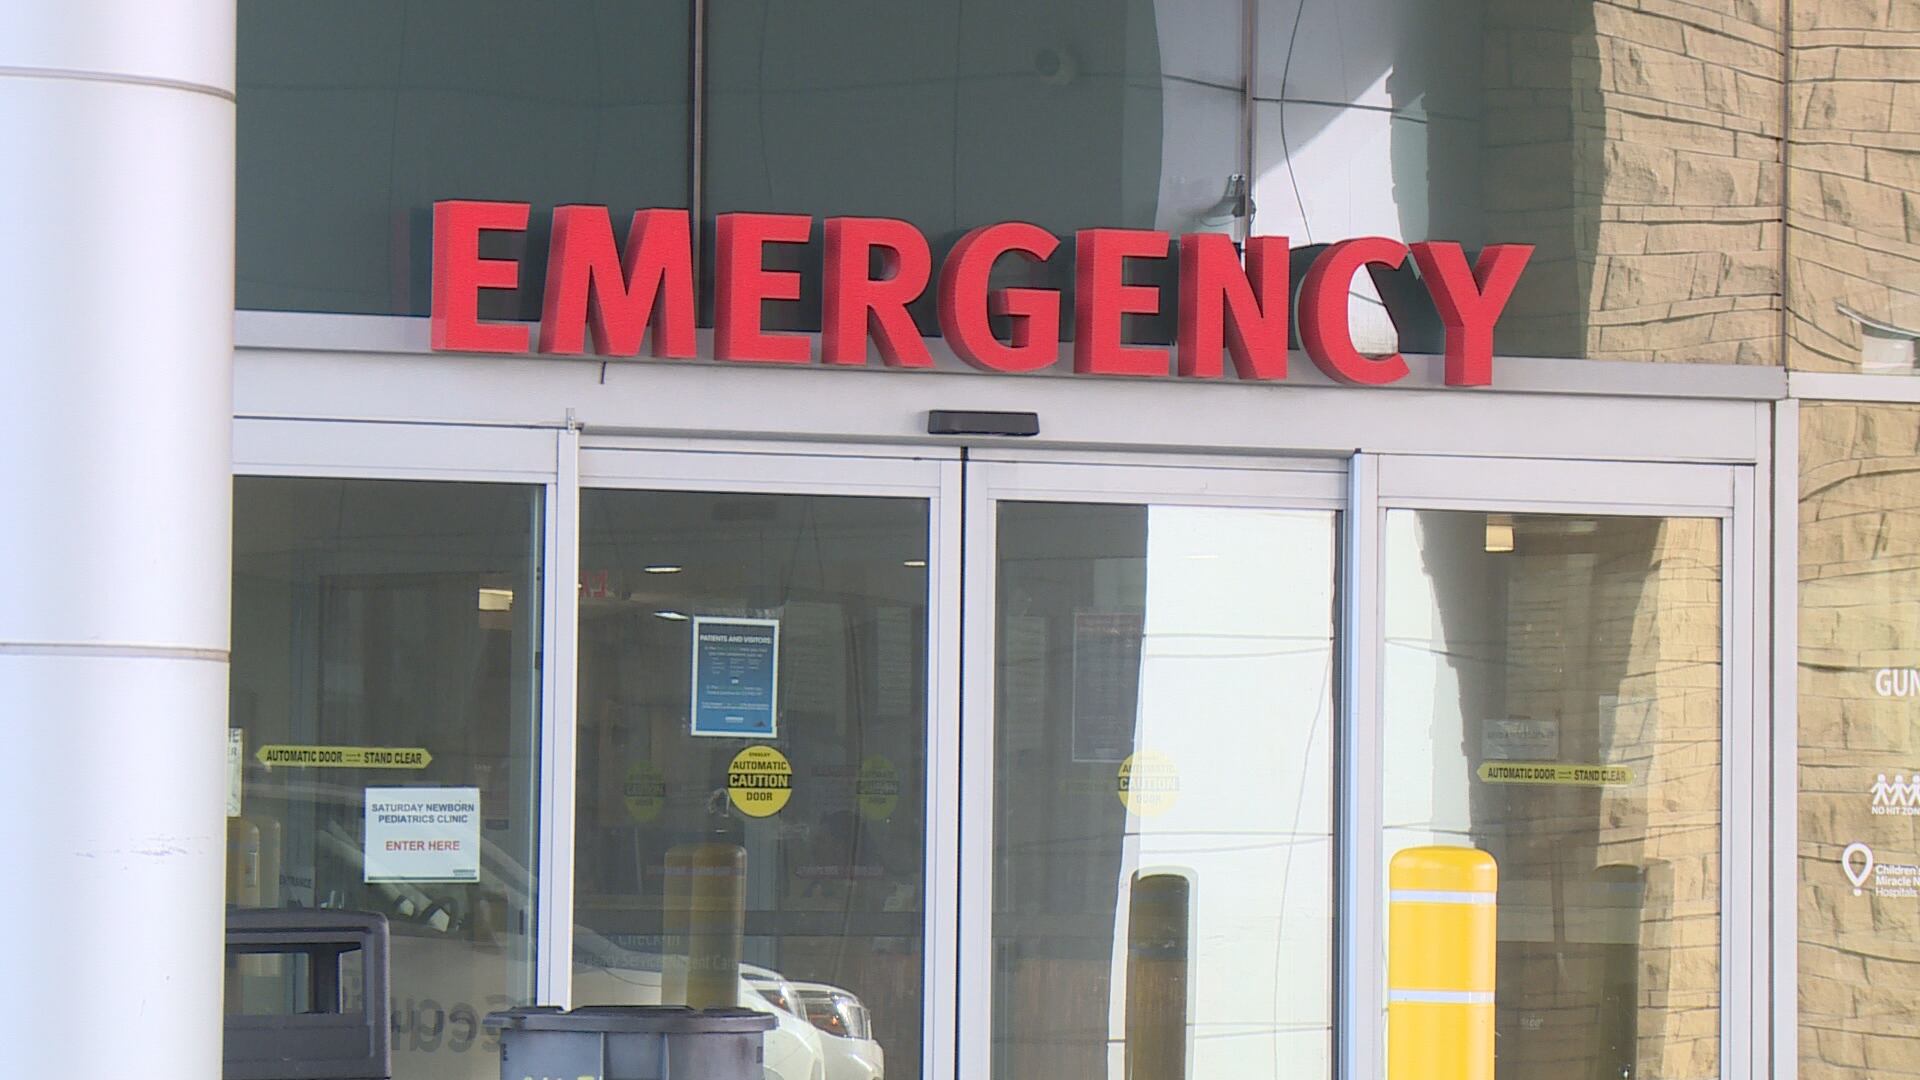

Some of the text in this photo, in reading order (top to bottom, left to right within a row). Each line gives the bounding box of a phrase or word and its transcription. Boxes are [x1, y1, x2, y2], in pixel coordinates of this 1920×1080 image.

[430, 199, 1536, 388] EMERGENCY
[728, 635, 743, 643] AND
[1875, 667, 1920, 698] GUN
[266, 749, 423, 765] AUTOMATIC DOOR STAND CLEAR
[732, 760, 788, 771] AUTOMATIC
[1487, 767, 1627, 782] AUTOMATIC DOOR STAND CLEAR
[729, 774, 789, 788] CAUTION
[746, 791, 773, 801] DOOR
[371, 803, 475, 812] SATURDAY NEWBORN
[1871, 805, 1885, 816] NO
[1886, 806, 1900, 816] HIT
[378, 814, 469, 824] PEDIATRICS CLINIC
[385, 840, 461, 852] ENTER HERE
[1875, 875, 1912, 887] Miracle
[1875, 887, 1918, 899] Hospitals
